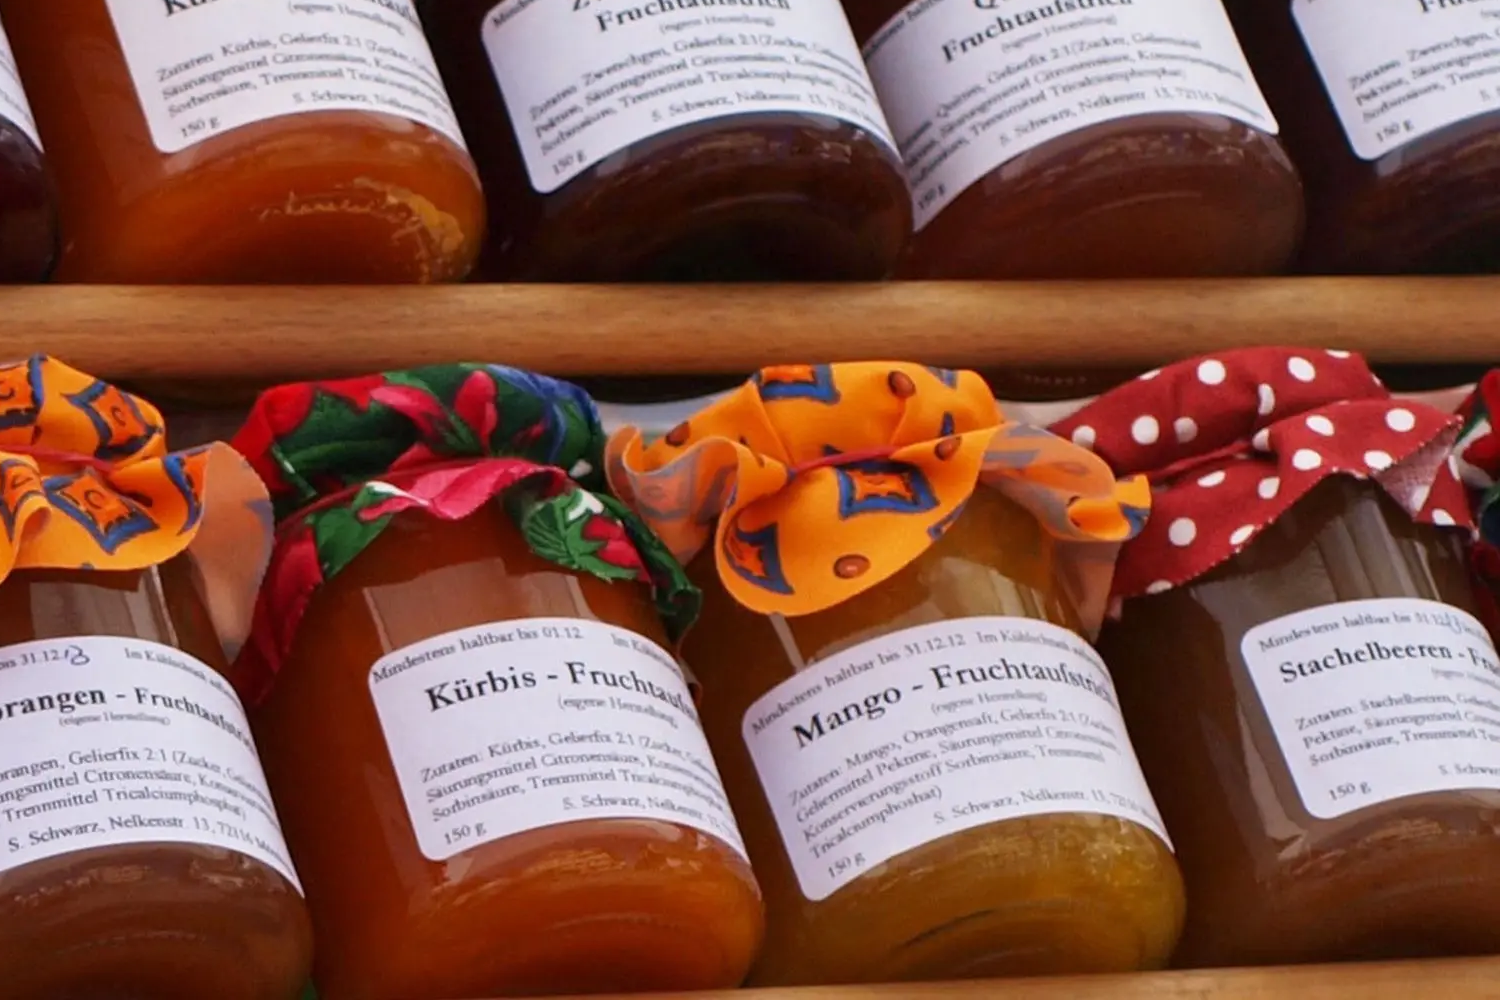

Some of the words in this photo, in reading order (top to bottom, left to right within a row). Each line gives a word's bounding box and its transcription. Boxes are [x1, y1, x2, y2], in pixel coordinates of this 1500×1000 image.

[372, 645, 456, 684] Mindestens
[460, 631, 515, 653] haltbar
[517, 627, 539, 640] bis
[824, 658, 875, 688] haltbar
[877, 646, 901, 668] bis
[1279, 641, 1453, 684] Stachelbeeren
[424, 665, 537, 713] Kürbis
[791, 683, 903, 749] Mango
[68, 746, 141, 766] Gelierfix
[420, 752, 483, 783] Zutaten:
[487, 733, 546, 758] Kürbis,
[844, 741, 903, 770] Mango,
[3, 790, 99, 825] Trennmittel
[431, 782, 526, 822] Sorbinsäure,
[1329, 783, 1357, 801] 150
[1360, 781, 1372, 794] g
[7, 836, 25, 854] S.
[29, 819, 106, 847] Schwarz,
[109, 815, 186, 832] Nelkenstr.
[443, 823, 472, 845] 150
[474, 822, 488, 838] g
[827, 856, 853, 879] 150
[854, 852, 866, 866] g
